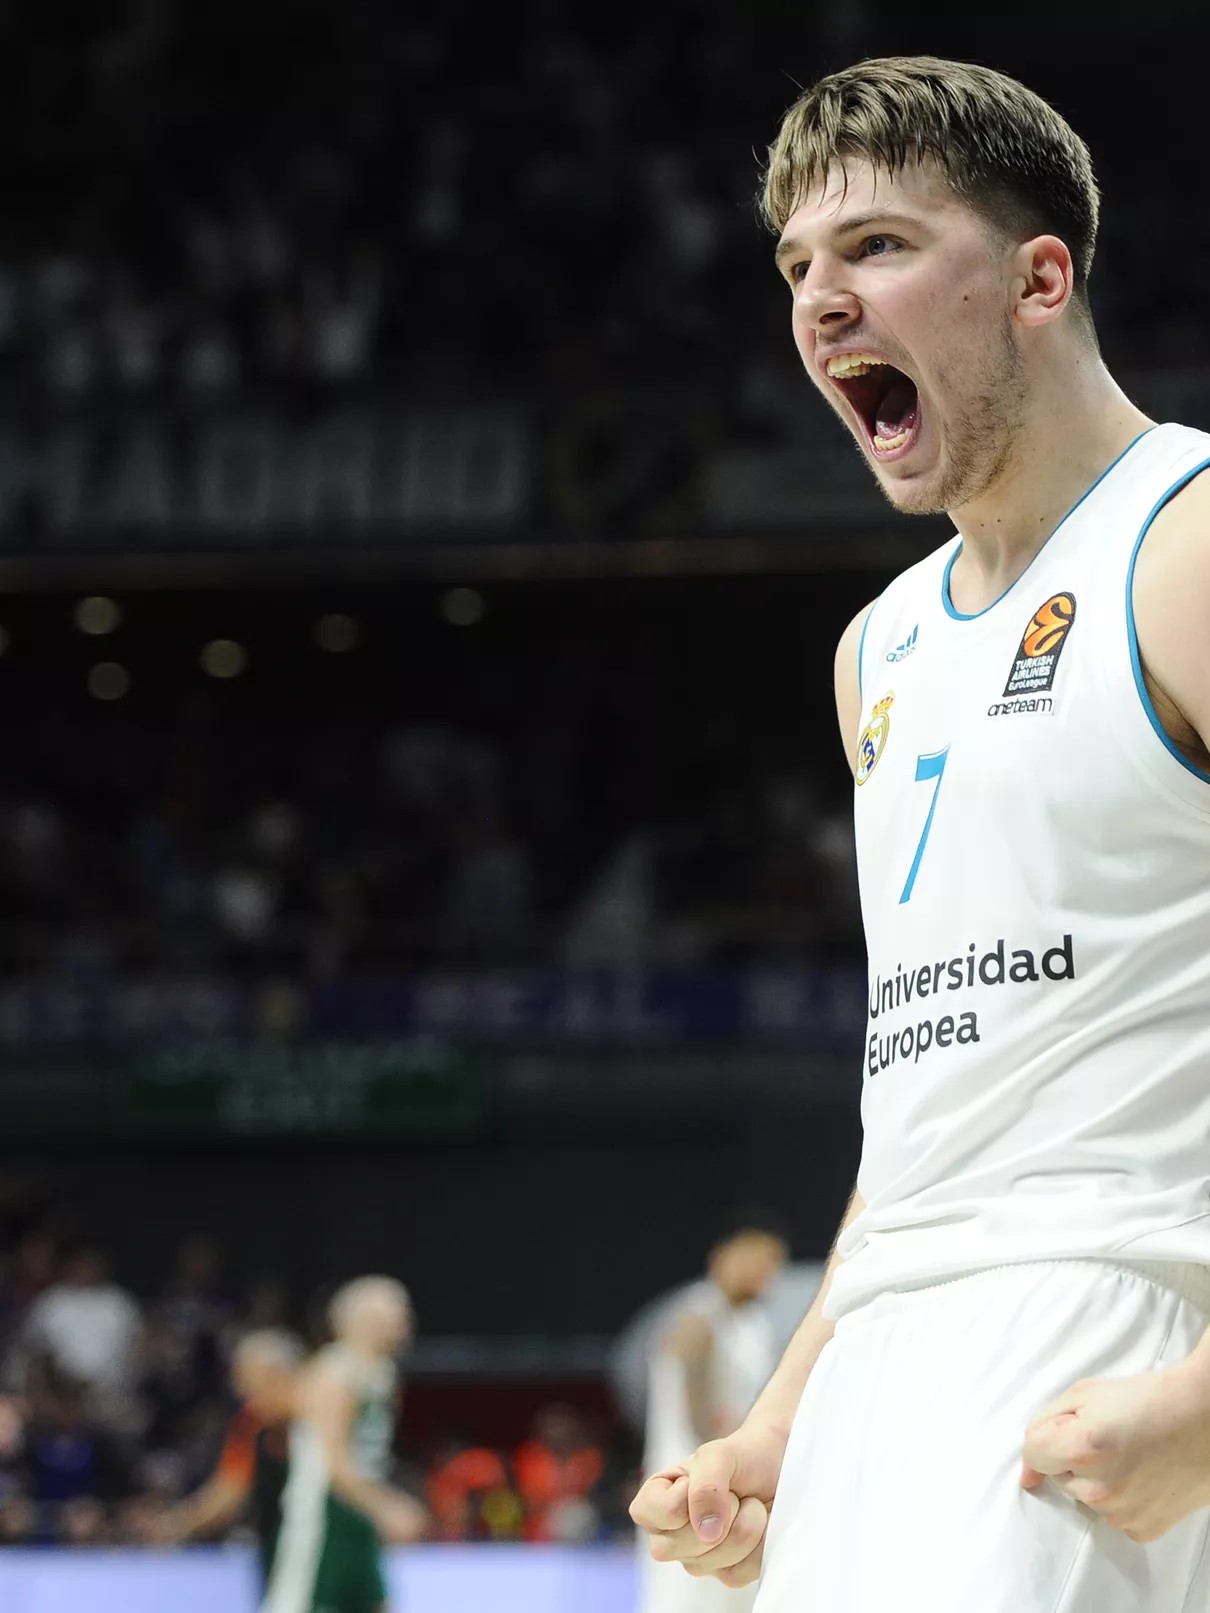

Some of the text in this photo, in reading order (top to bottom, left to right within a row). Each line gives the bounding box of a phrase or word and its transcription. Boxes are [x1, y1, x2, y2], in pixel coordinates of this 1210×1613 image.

[1011, 665, 1052, 681] AIRLINES
[1015, 655, 1055, 671] TURKISH
[987, 698, 1053, 717] oneteam
[898, 742, 951, 905] 7
[869, 934, 1076, 1019] Universidad
[868, 1011, 981, 1077] Europea
